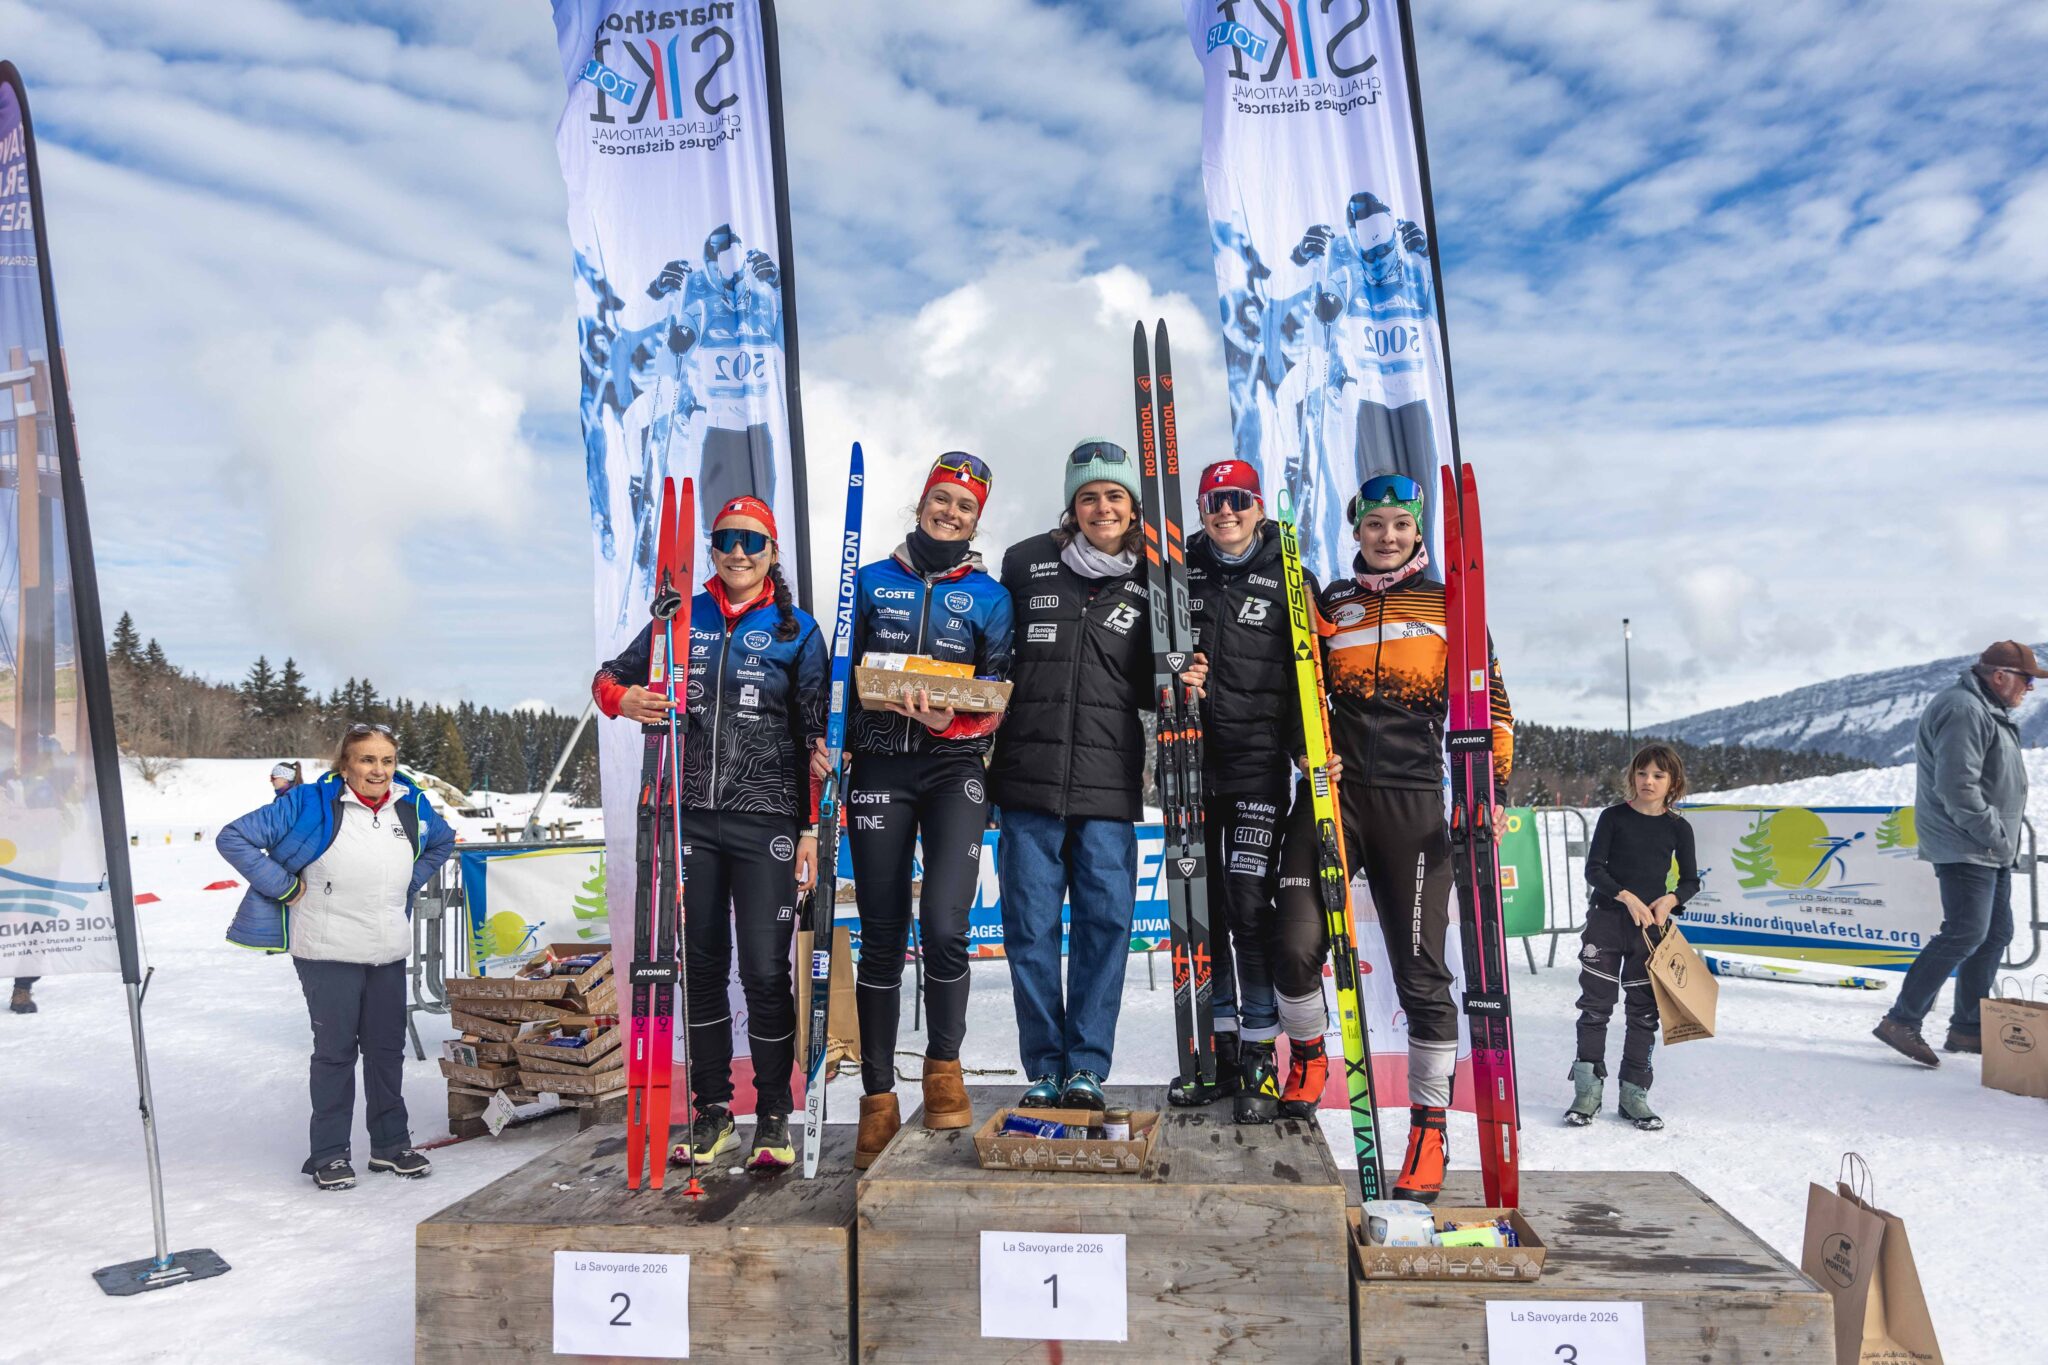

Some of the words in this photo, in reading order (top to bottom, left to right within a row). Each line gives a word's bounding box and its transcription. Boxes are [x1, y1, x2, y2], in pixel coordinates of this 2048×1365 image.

[1141, 403, 1156, 477] ROSSIGNOL
[1164, 401, 1179, 475] ROSSIGNOL
[850, 475, 863, 487] S
[1037, 562, 1059, 571] MAPEI
[1281, 521, 1307, 630] FISCHER
[837, 531, 859, 637] SALOMON
[874, 588, 916, 600] COSTE
[1247, 619, 1263, 627] TEAM
[1113, 625, 1128, 636] TEAM
[1451, 736, 1487, 745] ATOMIC
[851, 790, 890, 804] COSTE
[1248, 802, 1277, 815] MAPEI
[855, 815, 885, 830] TNE
[1413, 852, 1425, 957] AUVERGNE
[1680, 910, 1921, 947] www.skinordiquelafeclaz.org
[1468, 1000, 1501, 1009] ATOMIC
[1003, 1241, 1016, 1252] La
[1018, 1241, 1074, 1255] Savoyarde
[1076, 1243, 1104, 1254] 2026
[575, 1261, 587, 1271] La
[588, 1261, 641, 1274] Savoyarde
[642, 1263, 668, 1274] 2026
[1043, 1273, 1058, 1309] 1
[609, 1291, 632, 1326] 2
[1510, 1311, 1525, 1322] La
[1527, 1311, 1587, 1324] Savoyarde
[1589, 1312, 1619, 1322] 2026
[1554, 1343, 1578, 1365] 3
